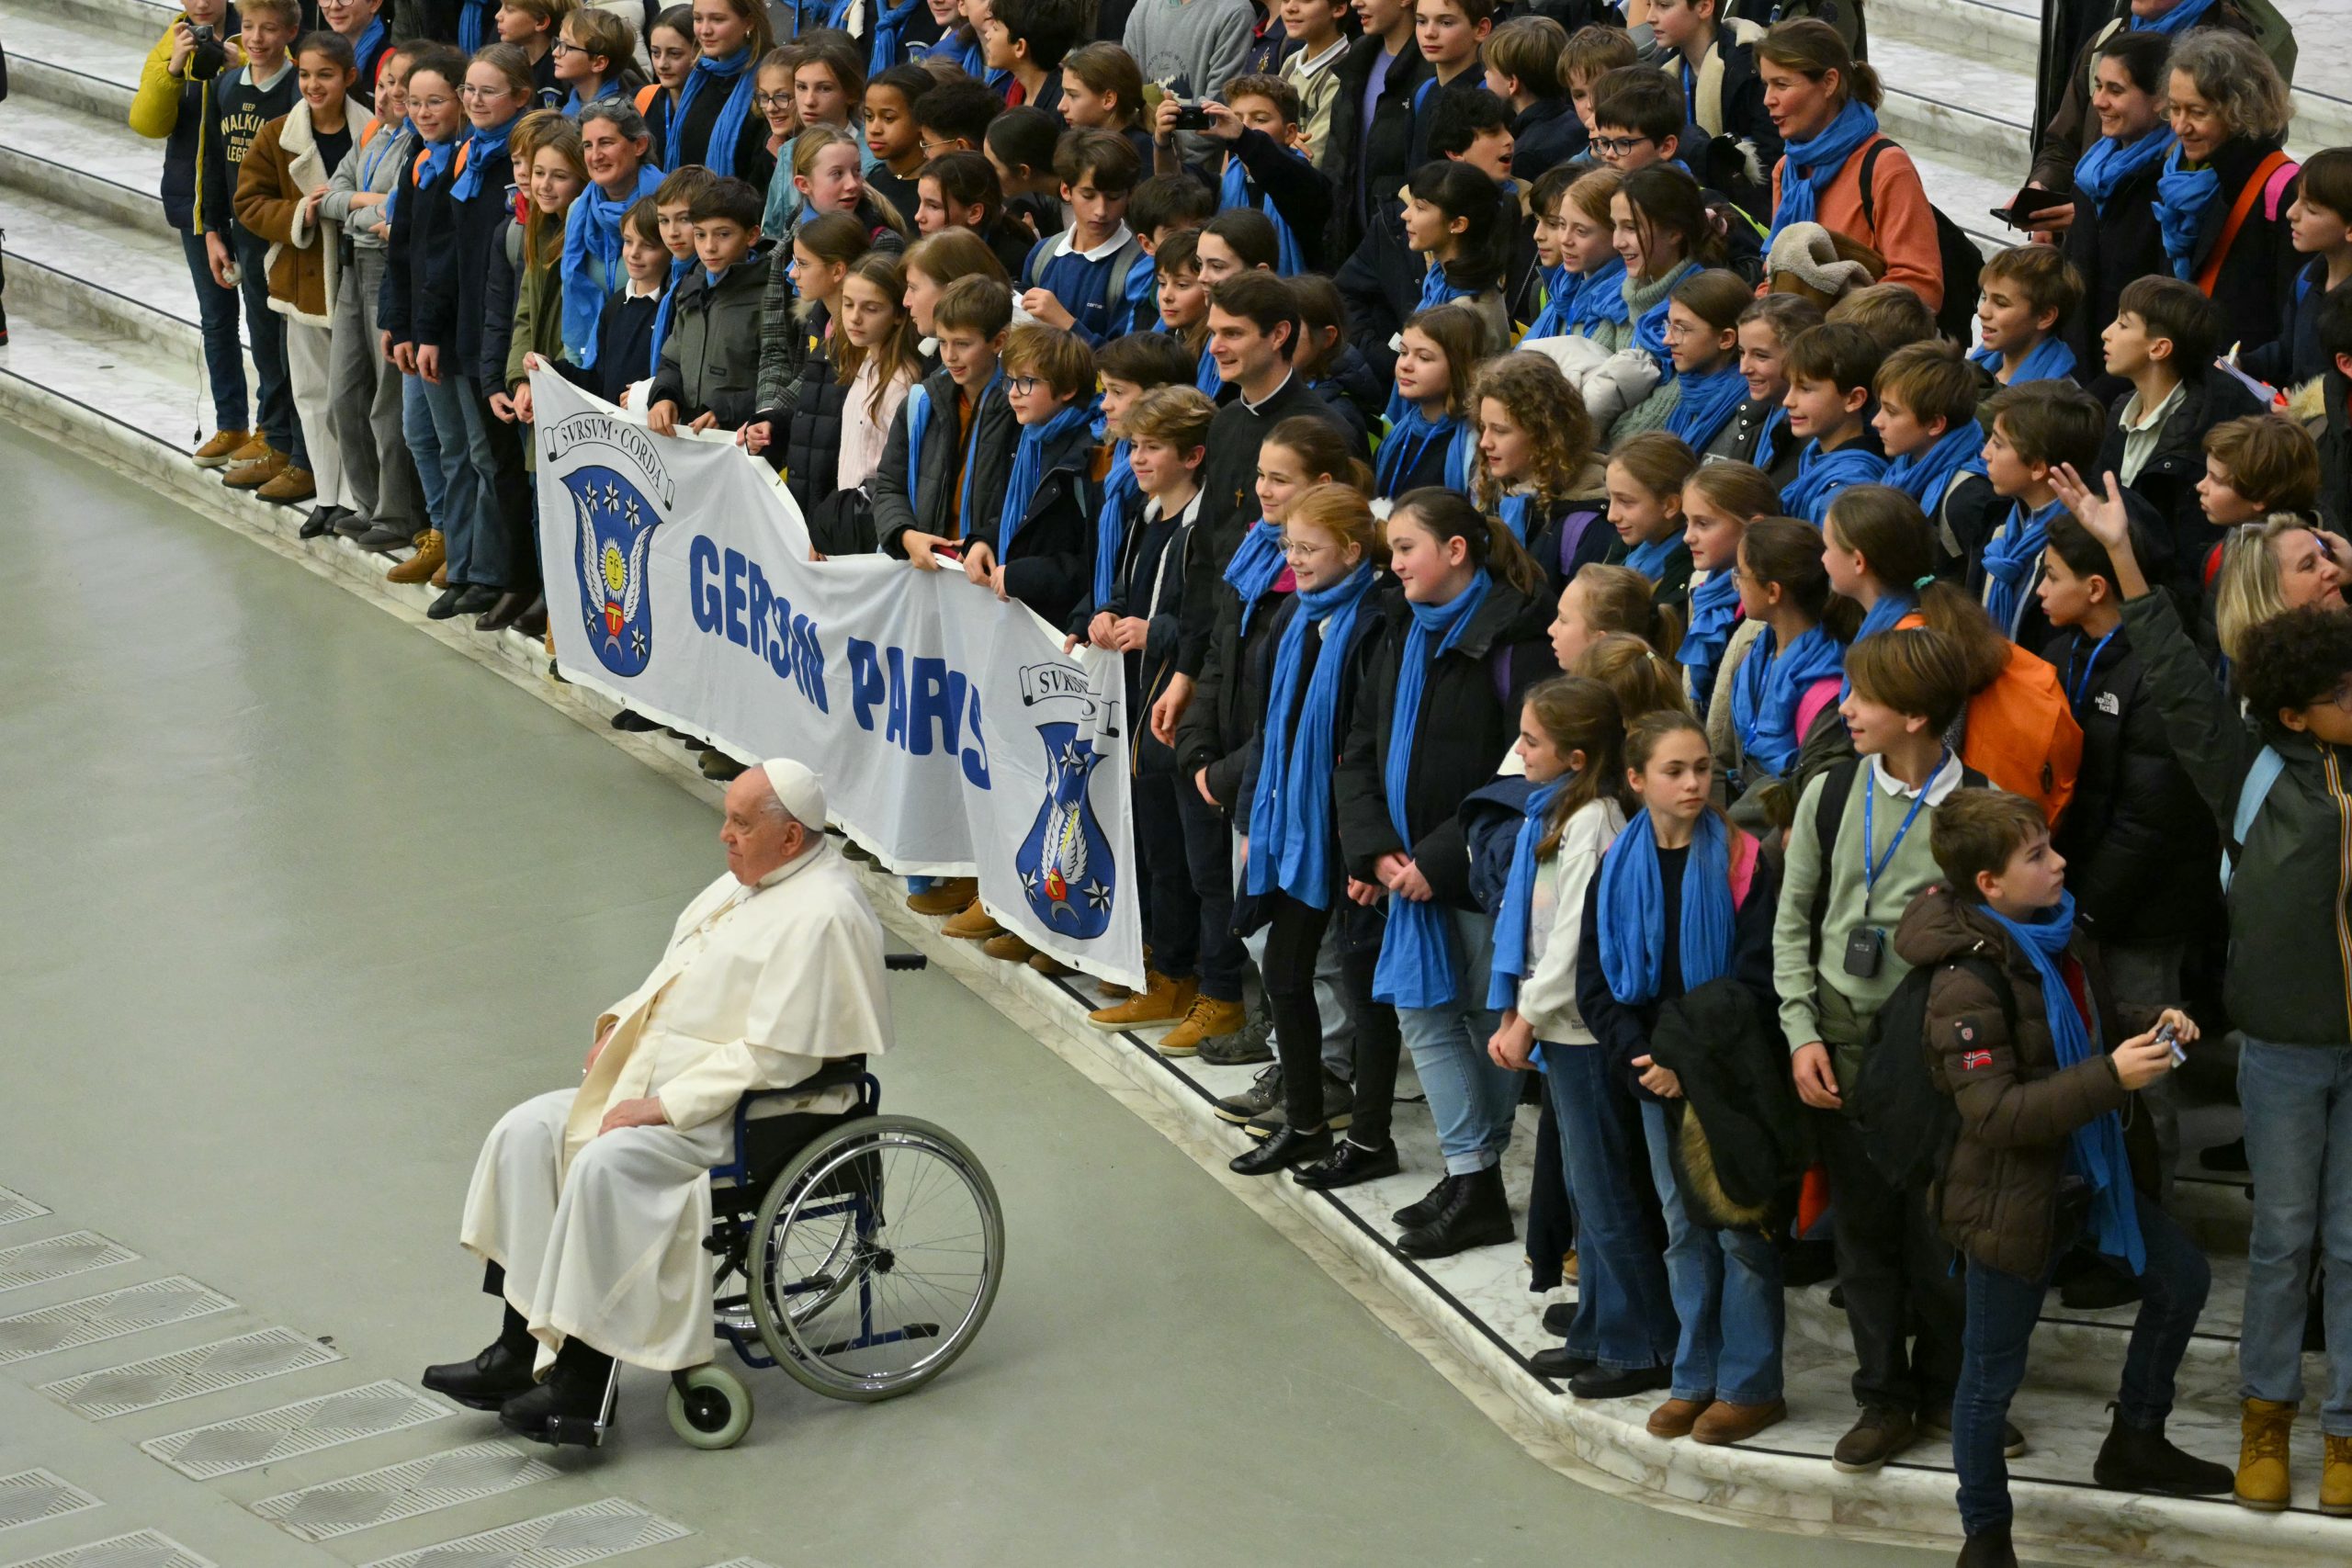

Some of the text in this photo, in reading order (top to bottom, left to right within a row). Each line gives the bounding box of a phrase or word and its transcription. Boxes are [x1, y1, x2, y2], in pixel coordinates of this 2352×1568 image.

[242, 102, 256, 112] KEEP
[560, 418, 662, 490] SVRSVM CORDA
[846, 636, 992, 791] PARIS
